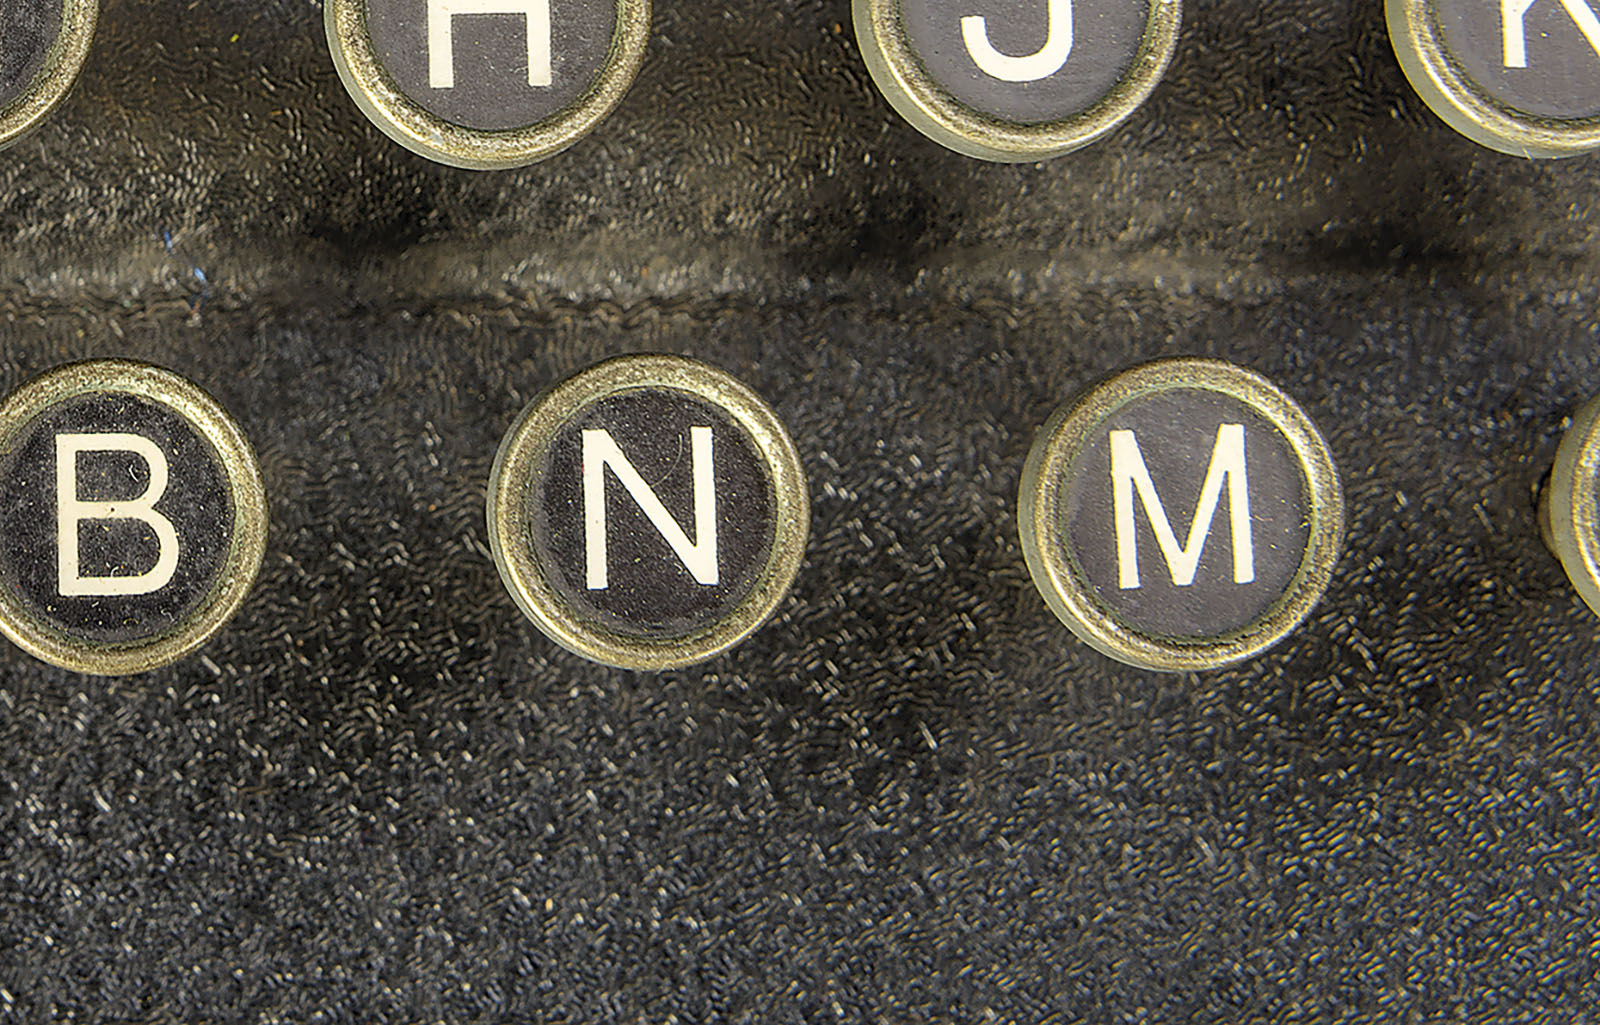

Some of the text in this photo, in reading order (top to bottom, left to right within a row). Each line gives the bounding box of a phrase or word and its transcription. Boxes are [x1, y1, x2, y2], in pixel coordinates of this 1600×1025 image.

[55, 432, 180, 597] B
[581, 426, 719, 590] N
[1109, 423, 1255, 589] M
